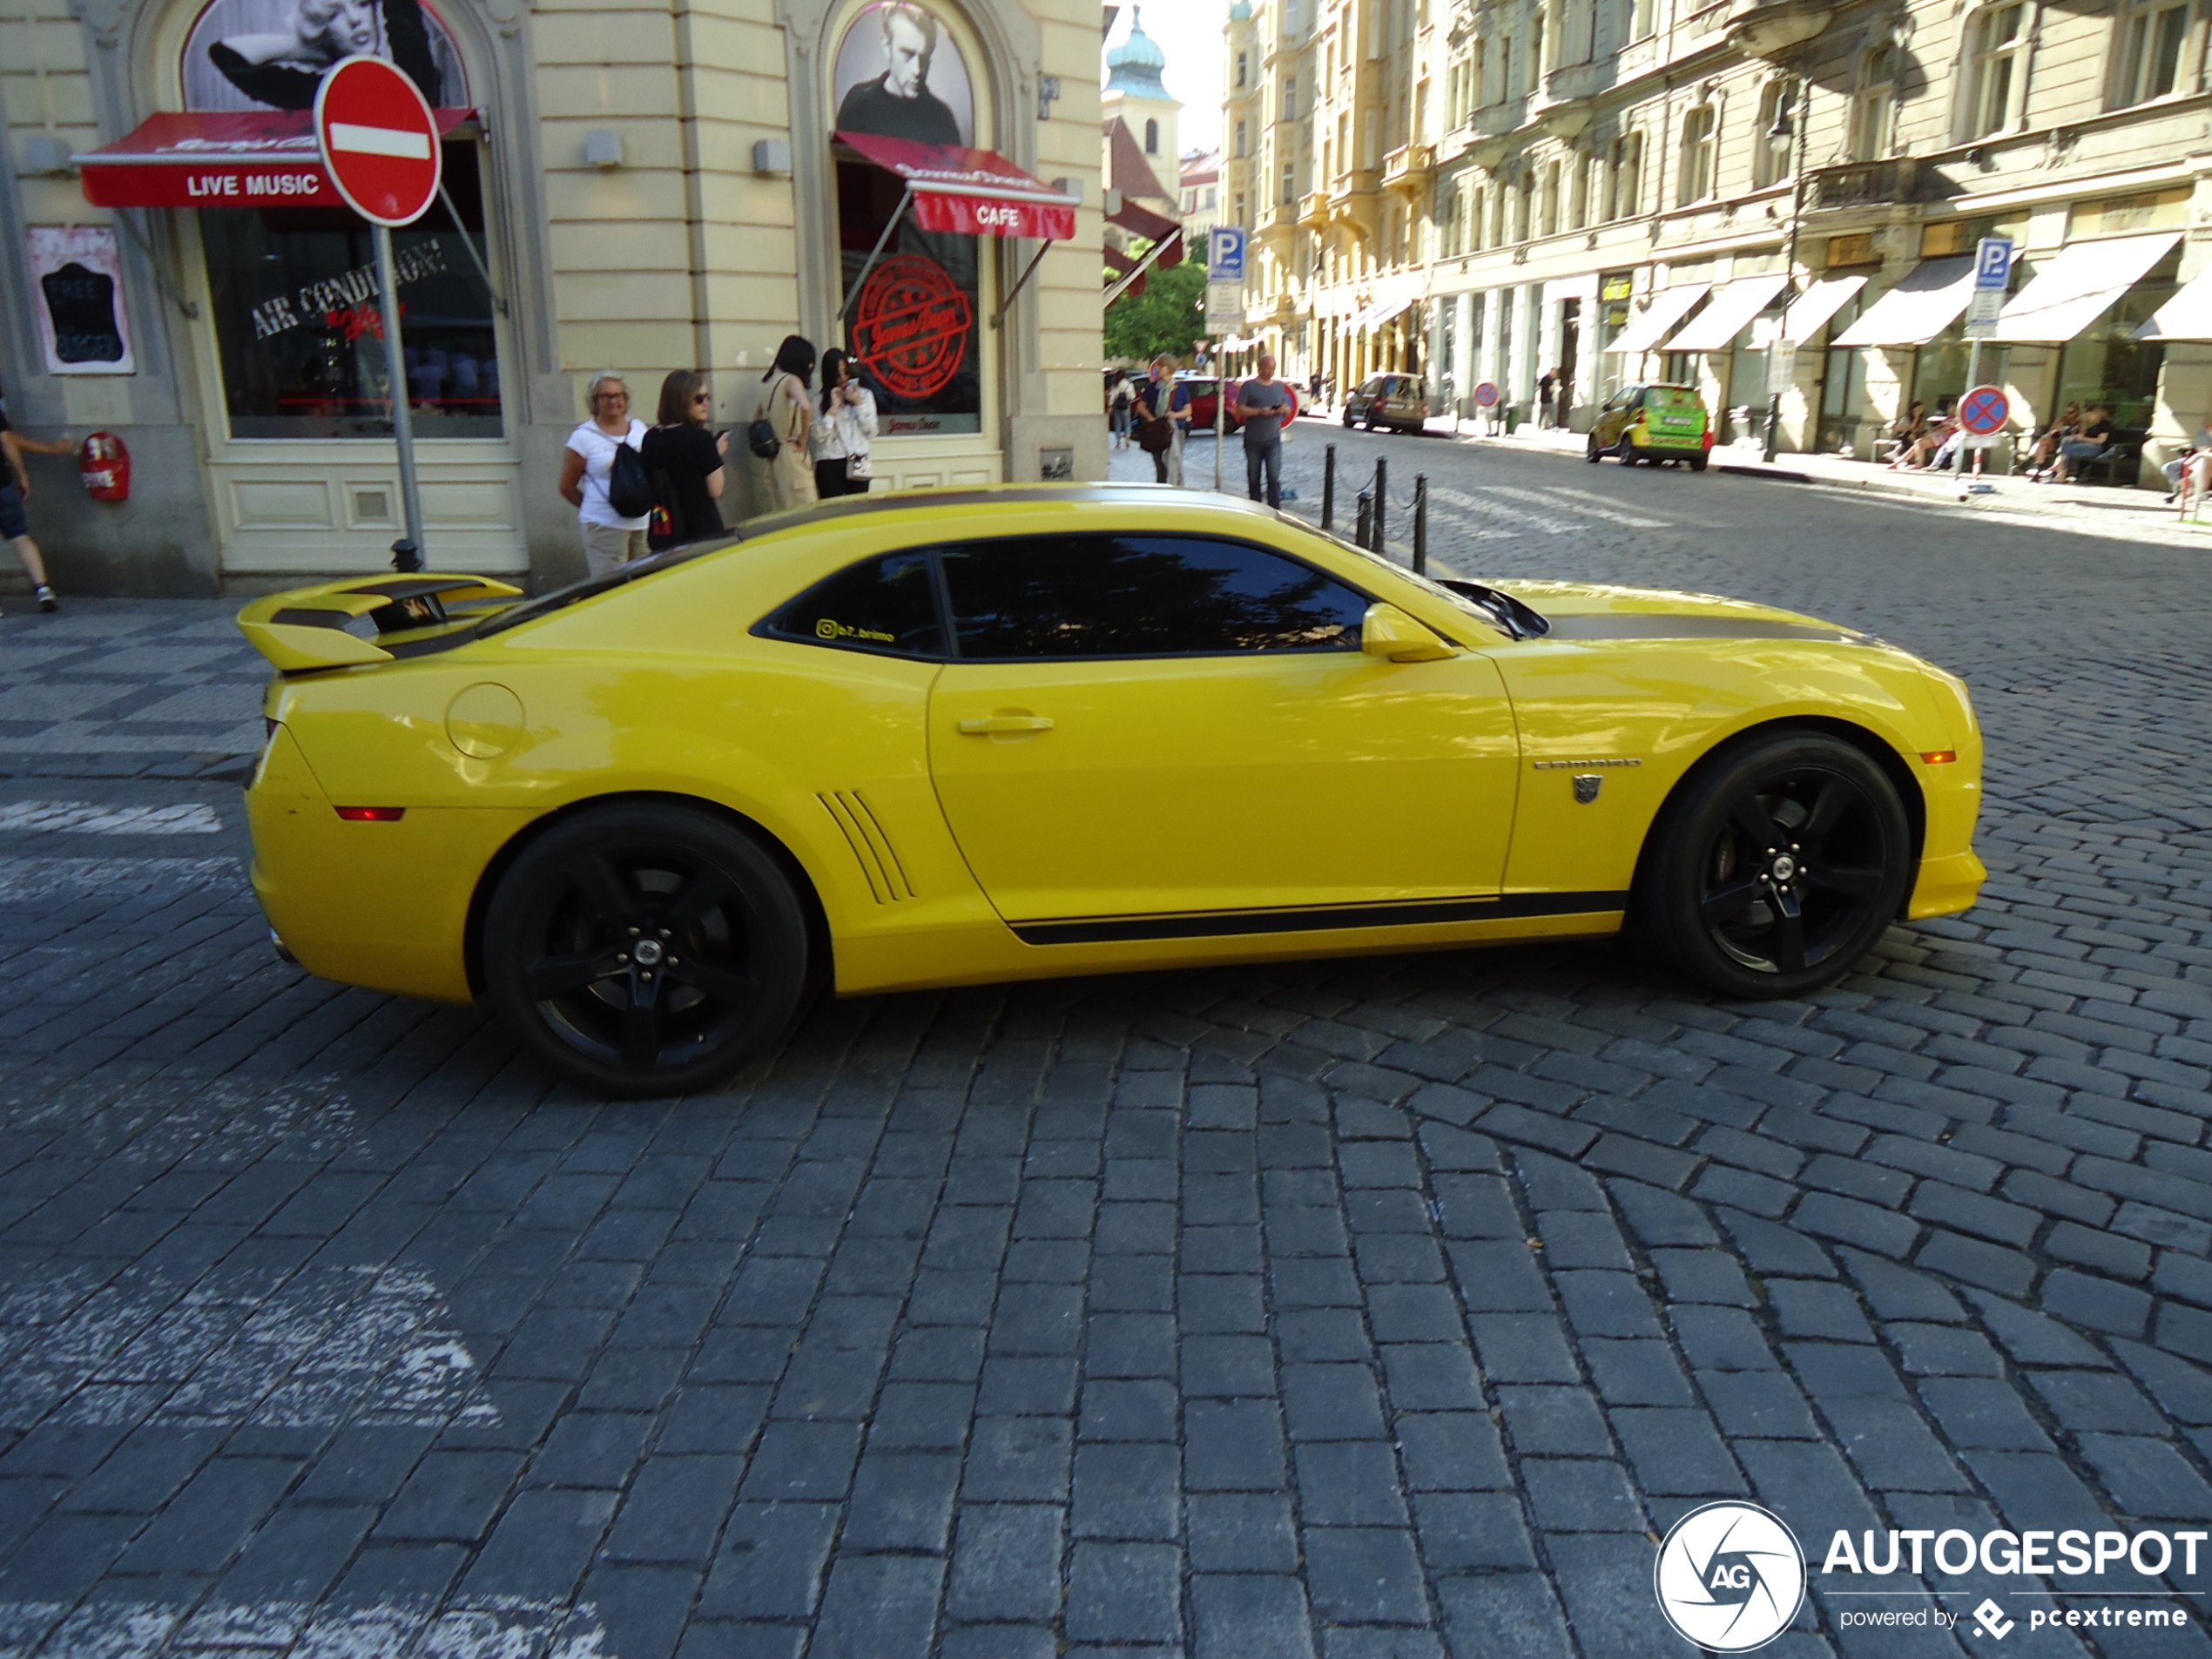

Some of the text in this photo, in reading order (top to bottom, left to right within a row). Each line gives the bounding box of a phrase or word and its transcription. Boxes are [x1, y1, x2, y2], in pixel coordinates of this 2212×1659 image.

[187, 174, 319, 196] LIVE MUSIC
[976, 206, 1019, 227] CAFE
[1216, 233, 1238, 264] P
[1982, 245, 2006, 275] P
[252, 296, 300, 340] AIR
